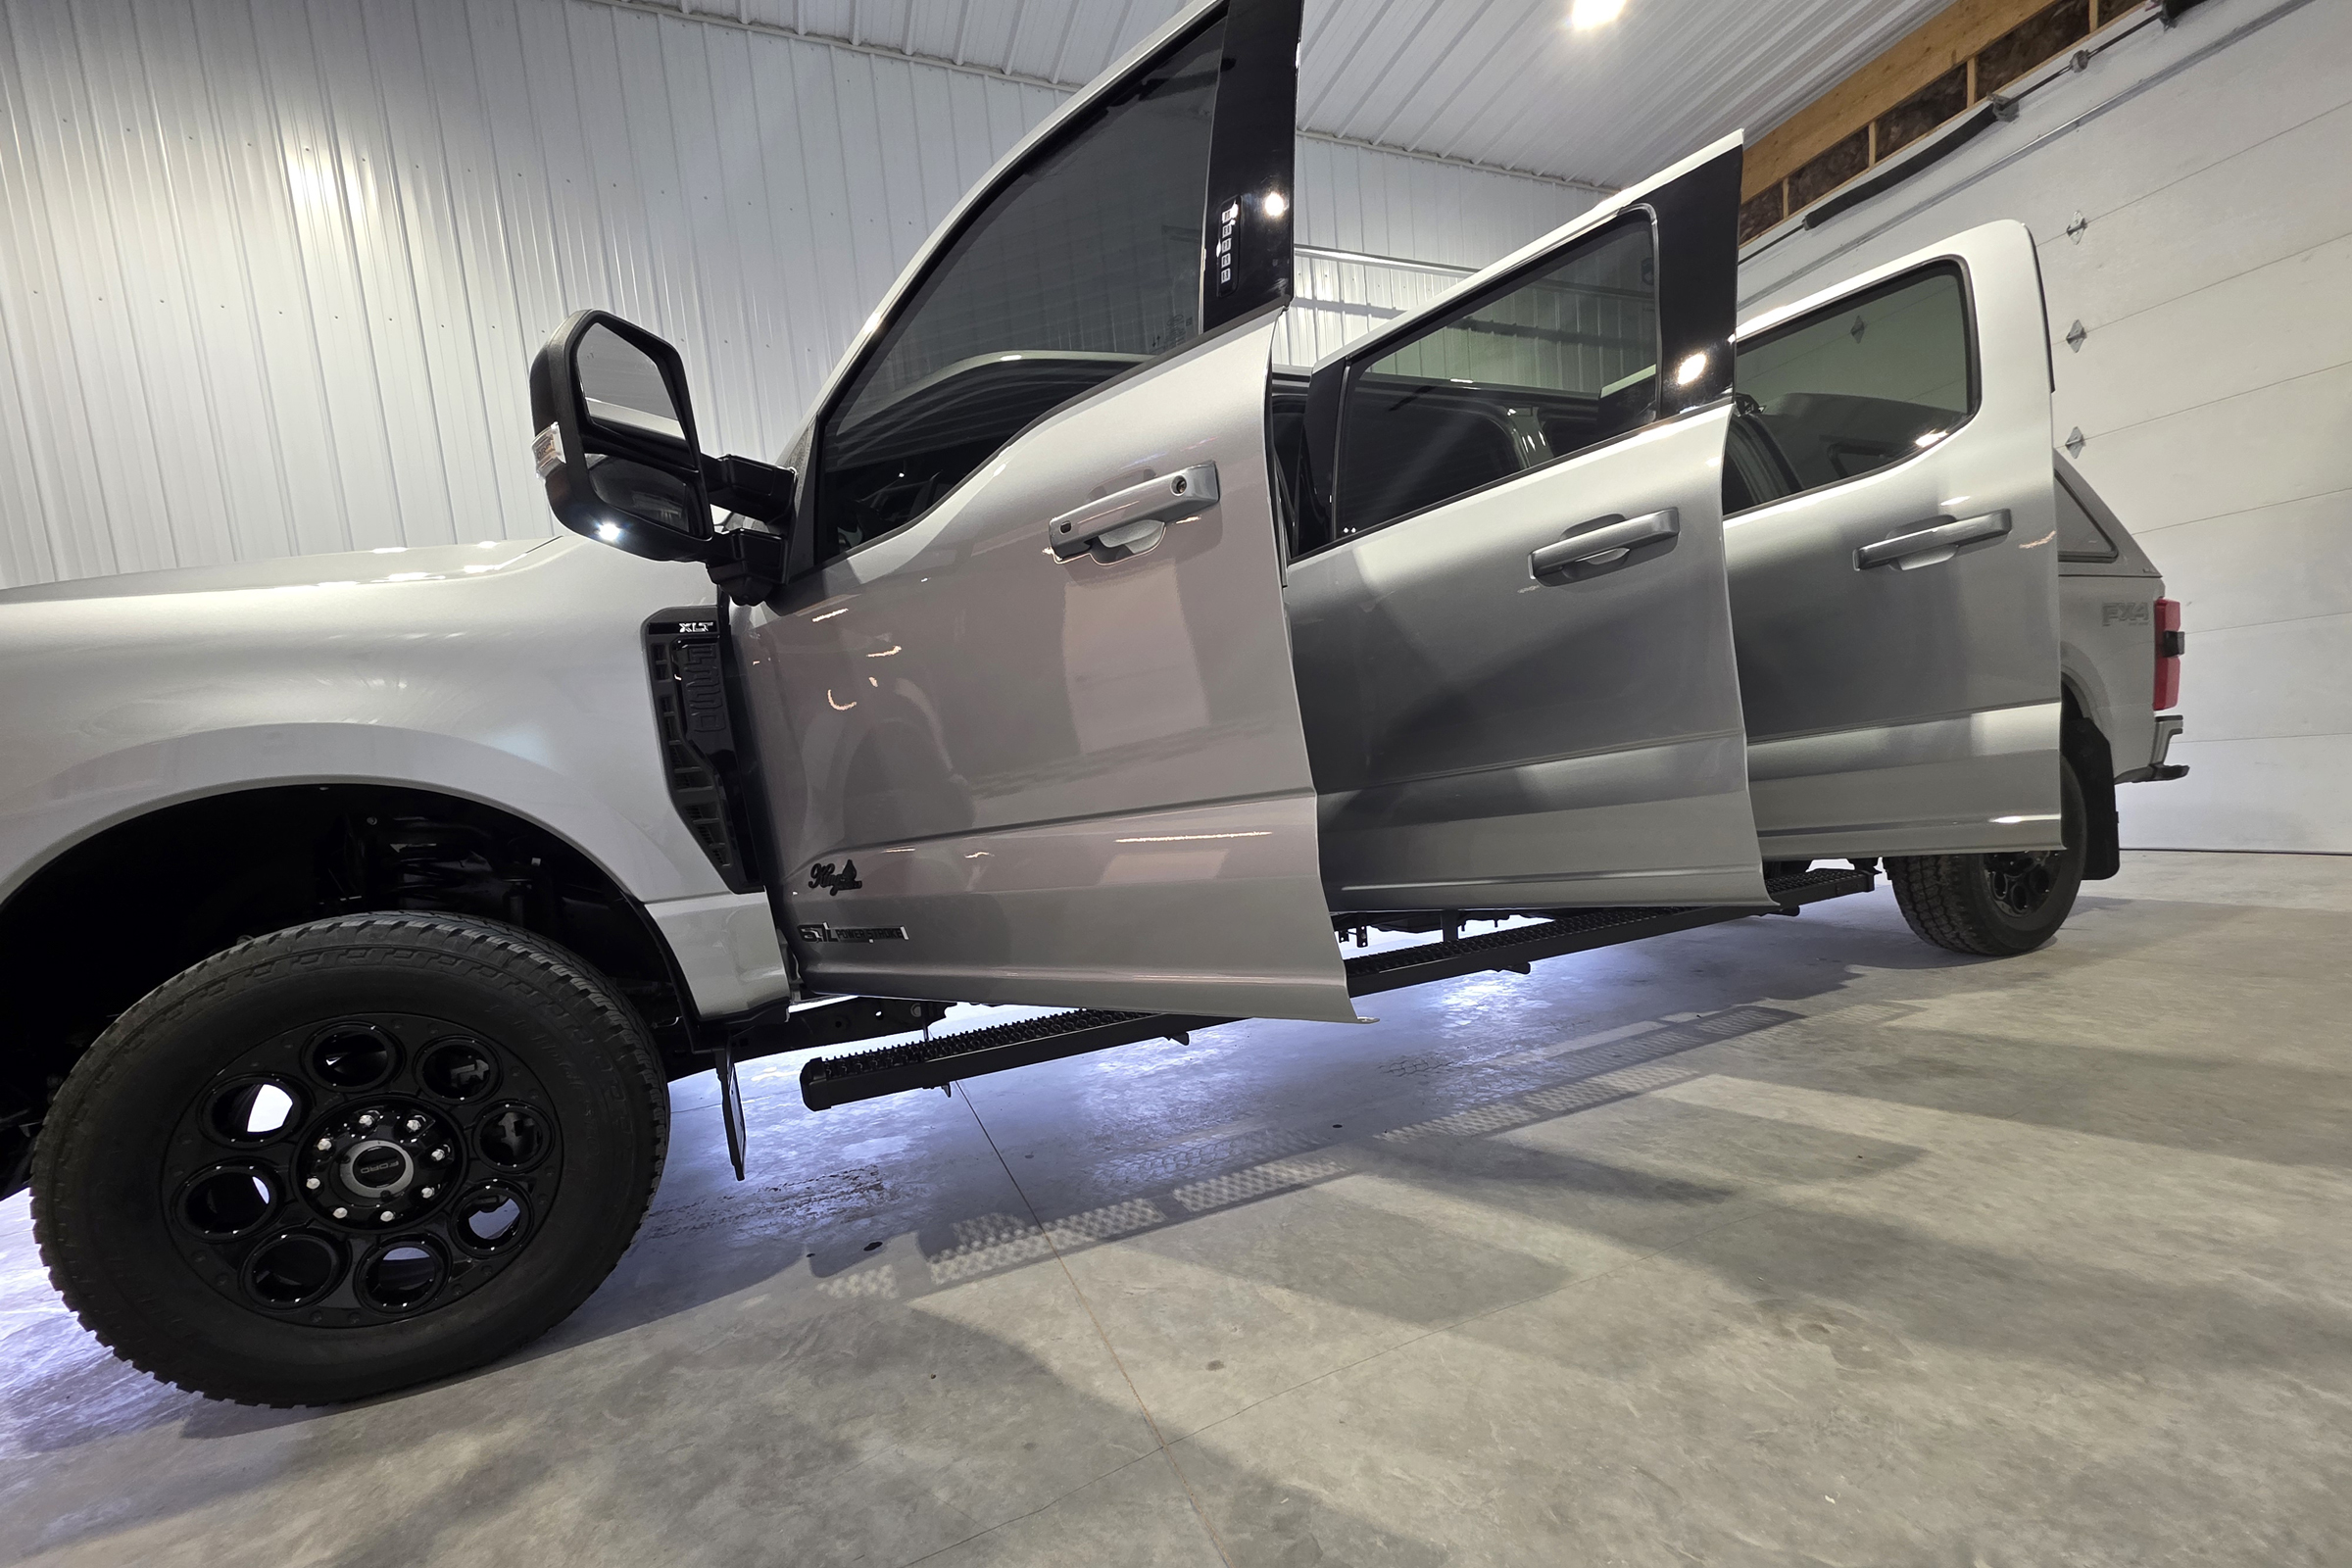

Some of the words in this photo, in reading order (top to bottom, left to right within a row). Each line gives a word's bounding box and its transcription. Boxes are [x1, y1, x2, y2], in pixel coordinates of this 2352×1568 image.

[2102, 602, 2150, 627] FX4
[679, 622, 713, 633] XLT
[836, 929, 864, 940] POWER
[867, 928, 903, 939] STROKE
[360, 1160, 400, 1174] FORD
